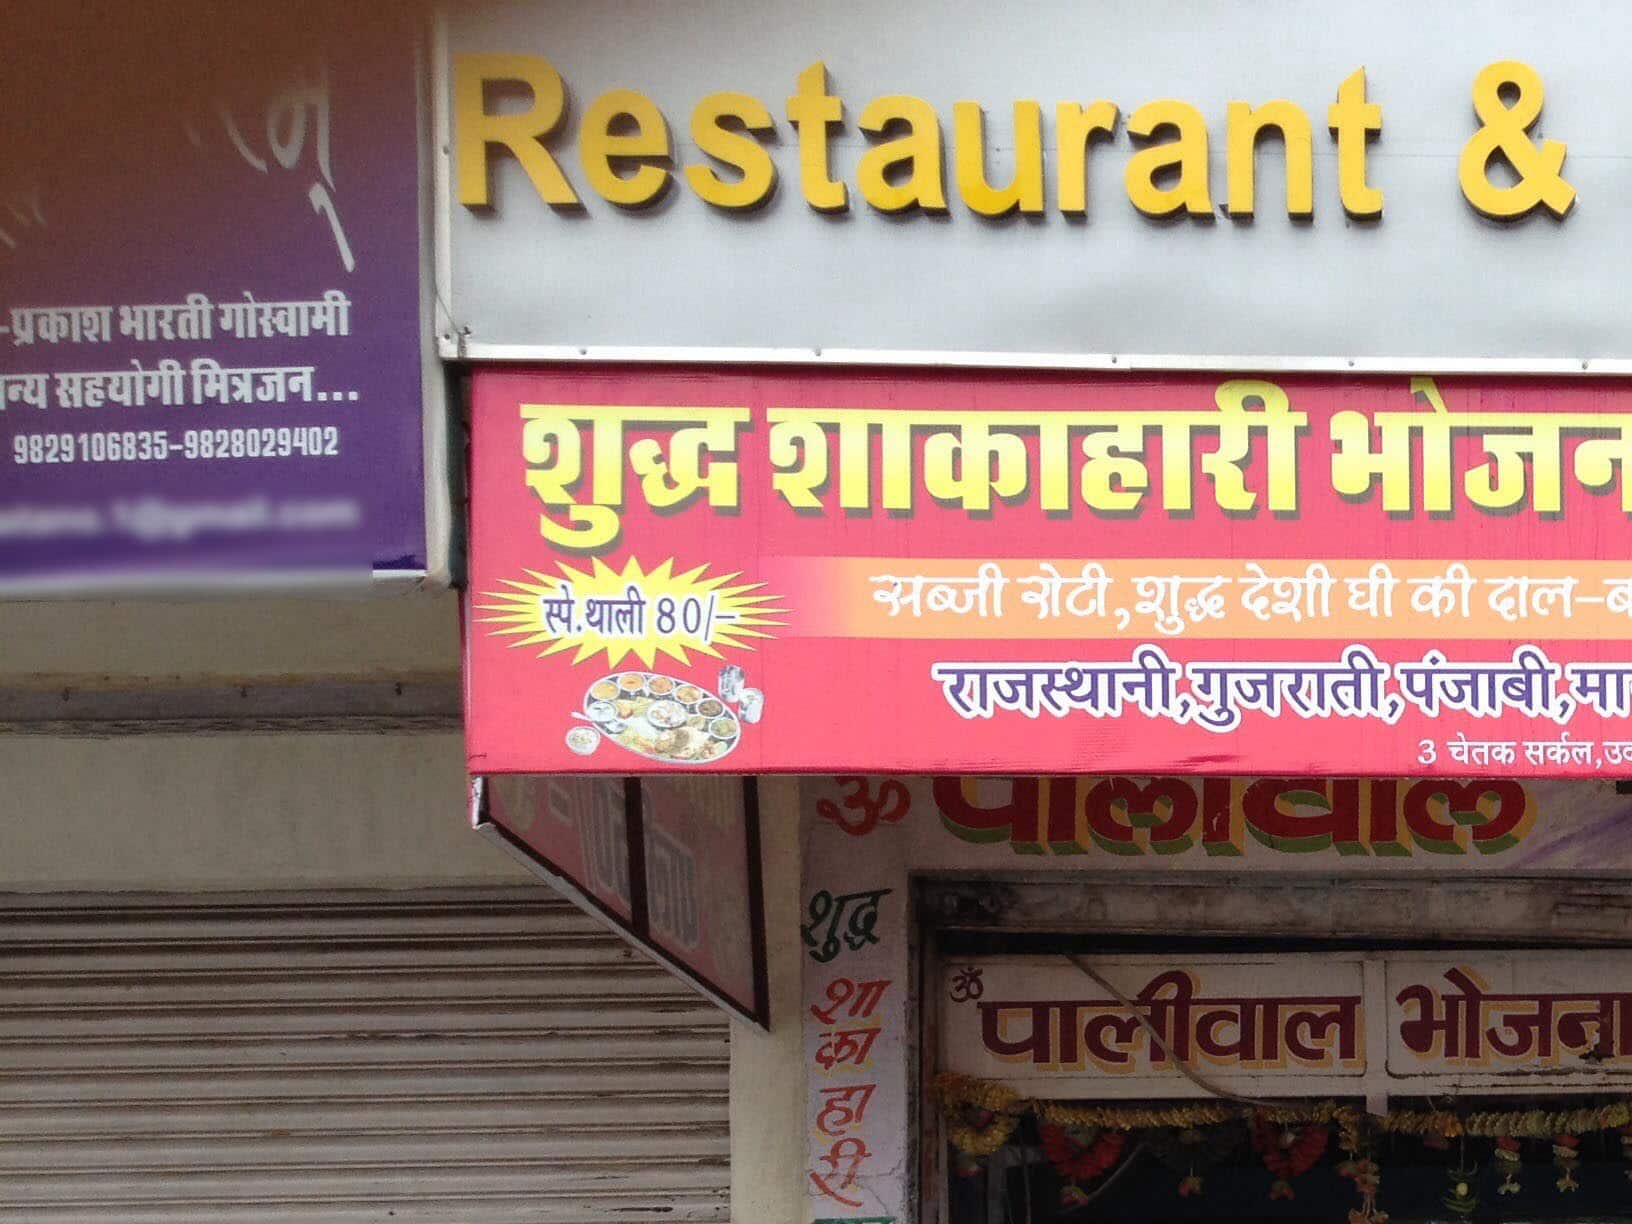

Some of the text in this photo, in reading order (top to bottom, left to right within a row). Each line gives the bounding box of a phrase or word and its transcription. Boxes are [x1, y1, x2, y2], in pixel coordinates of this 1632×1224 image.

[452, 52, 1383, 220] Restaurant
[1459, 59, 1578, 225] &
[118, 293, 213, 341] भारती
[219, 291, 351, 338] गोस्वामी
[55, 359, 185, 408] सहयोगी
[13, 426, 339, 464] 9829106835-9828029402
[520, 403, 751, 550] शुद्ध
[767, 380, 1308, 517] शाकाहारी
[870, 561, 1009, 619] सब्जी
[1241, 563, 1332, 618] देशी
[1345, 563, 1394, 618] घी
[1408, 563, 1474, 618] की
[656, 594, 737, 644] 80/-
[1417, 739, 1438, 764] 3
[1447, 731, 1516, 764] चेतक
[977, 968, 1362, 1068] पालीवाल
